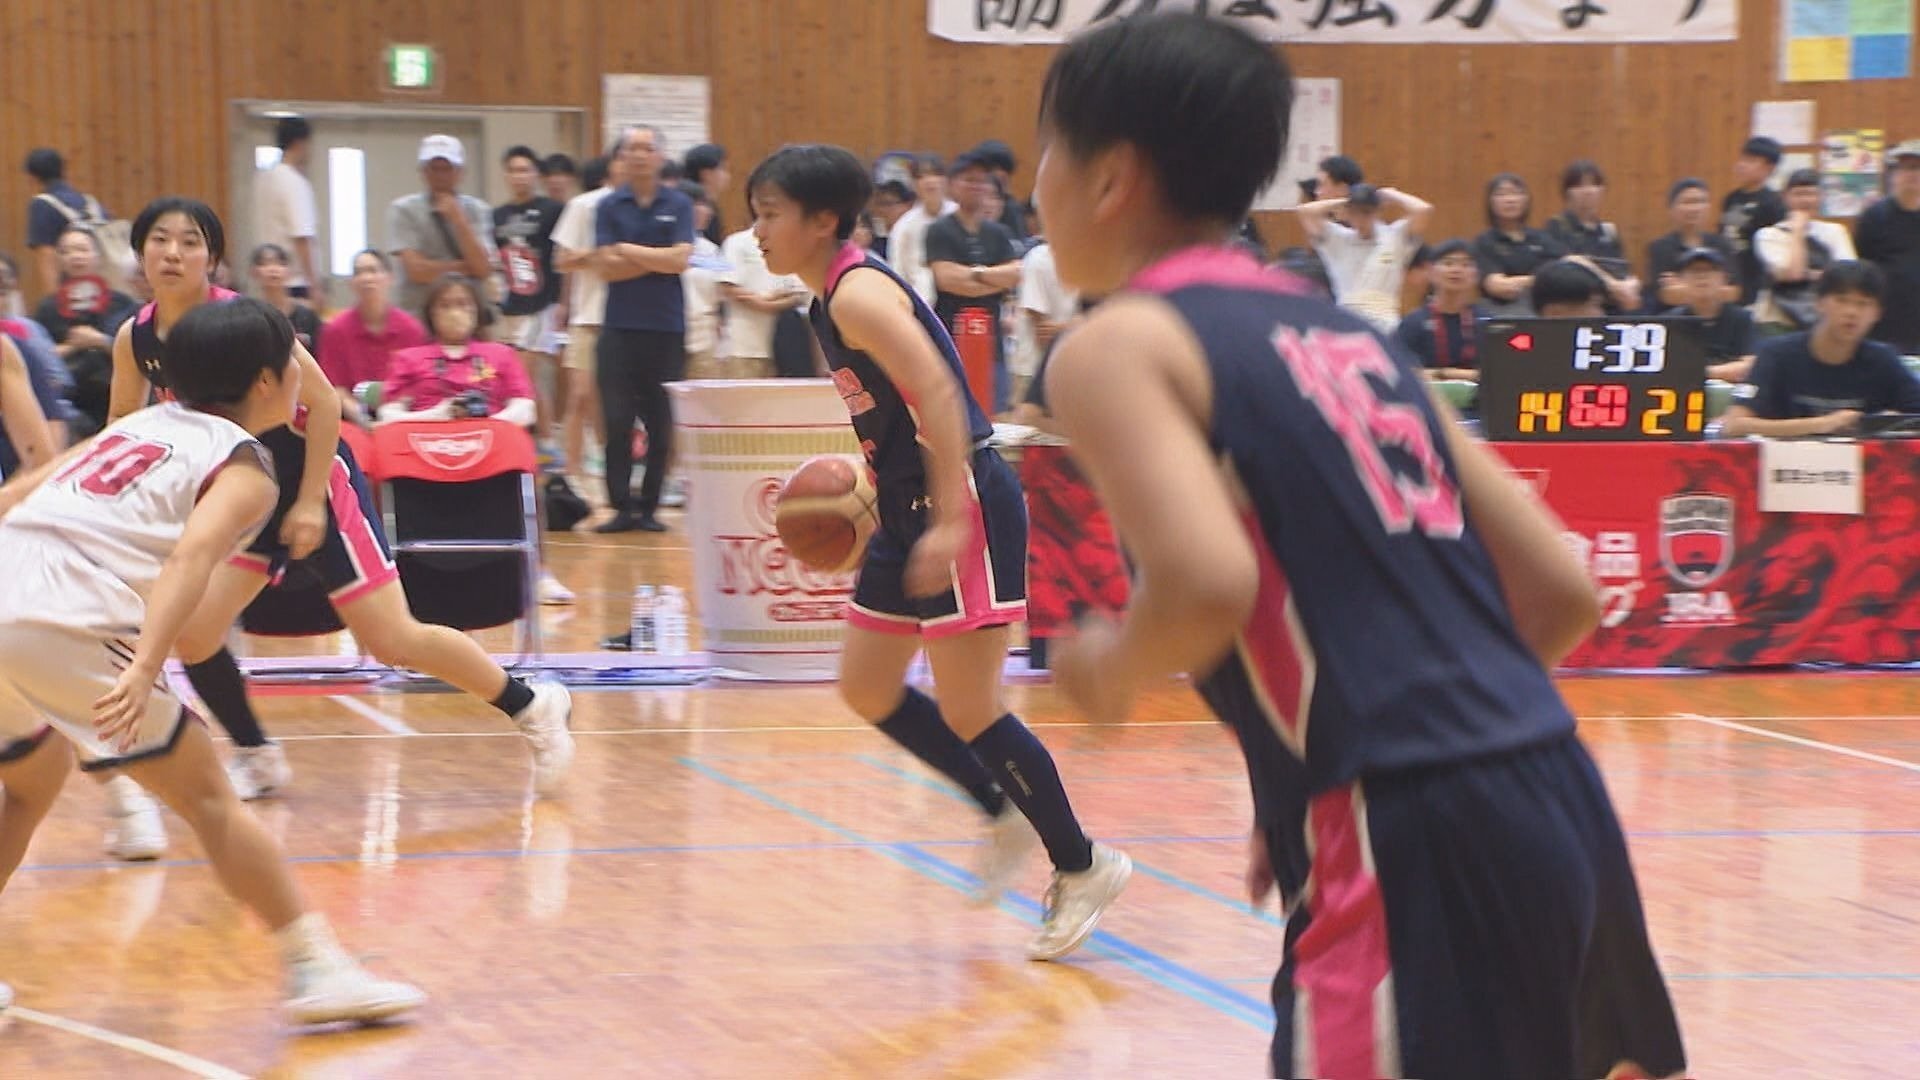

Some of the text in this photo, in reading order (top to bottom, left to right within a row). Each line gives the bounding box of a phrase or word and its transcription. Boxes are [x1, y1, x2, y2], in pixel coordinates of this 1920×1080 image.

[1269, 323, 1465, 540] 15
[1518, 391, 1564, 433] 14
[1640, 388, 1704, 435] 21
[49, 430, 173, 500] 10
